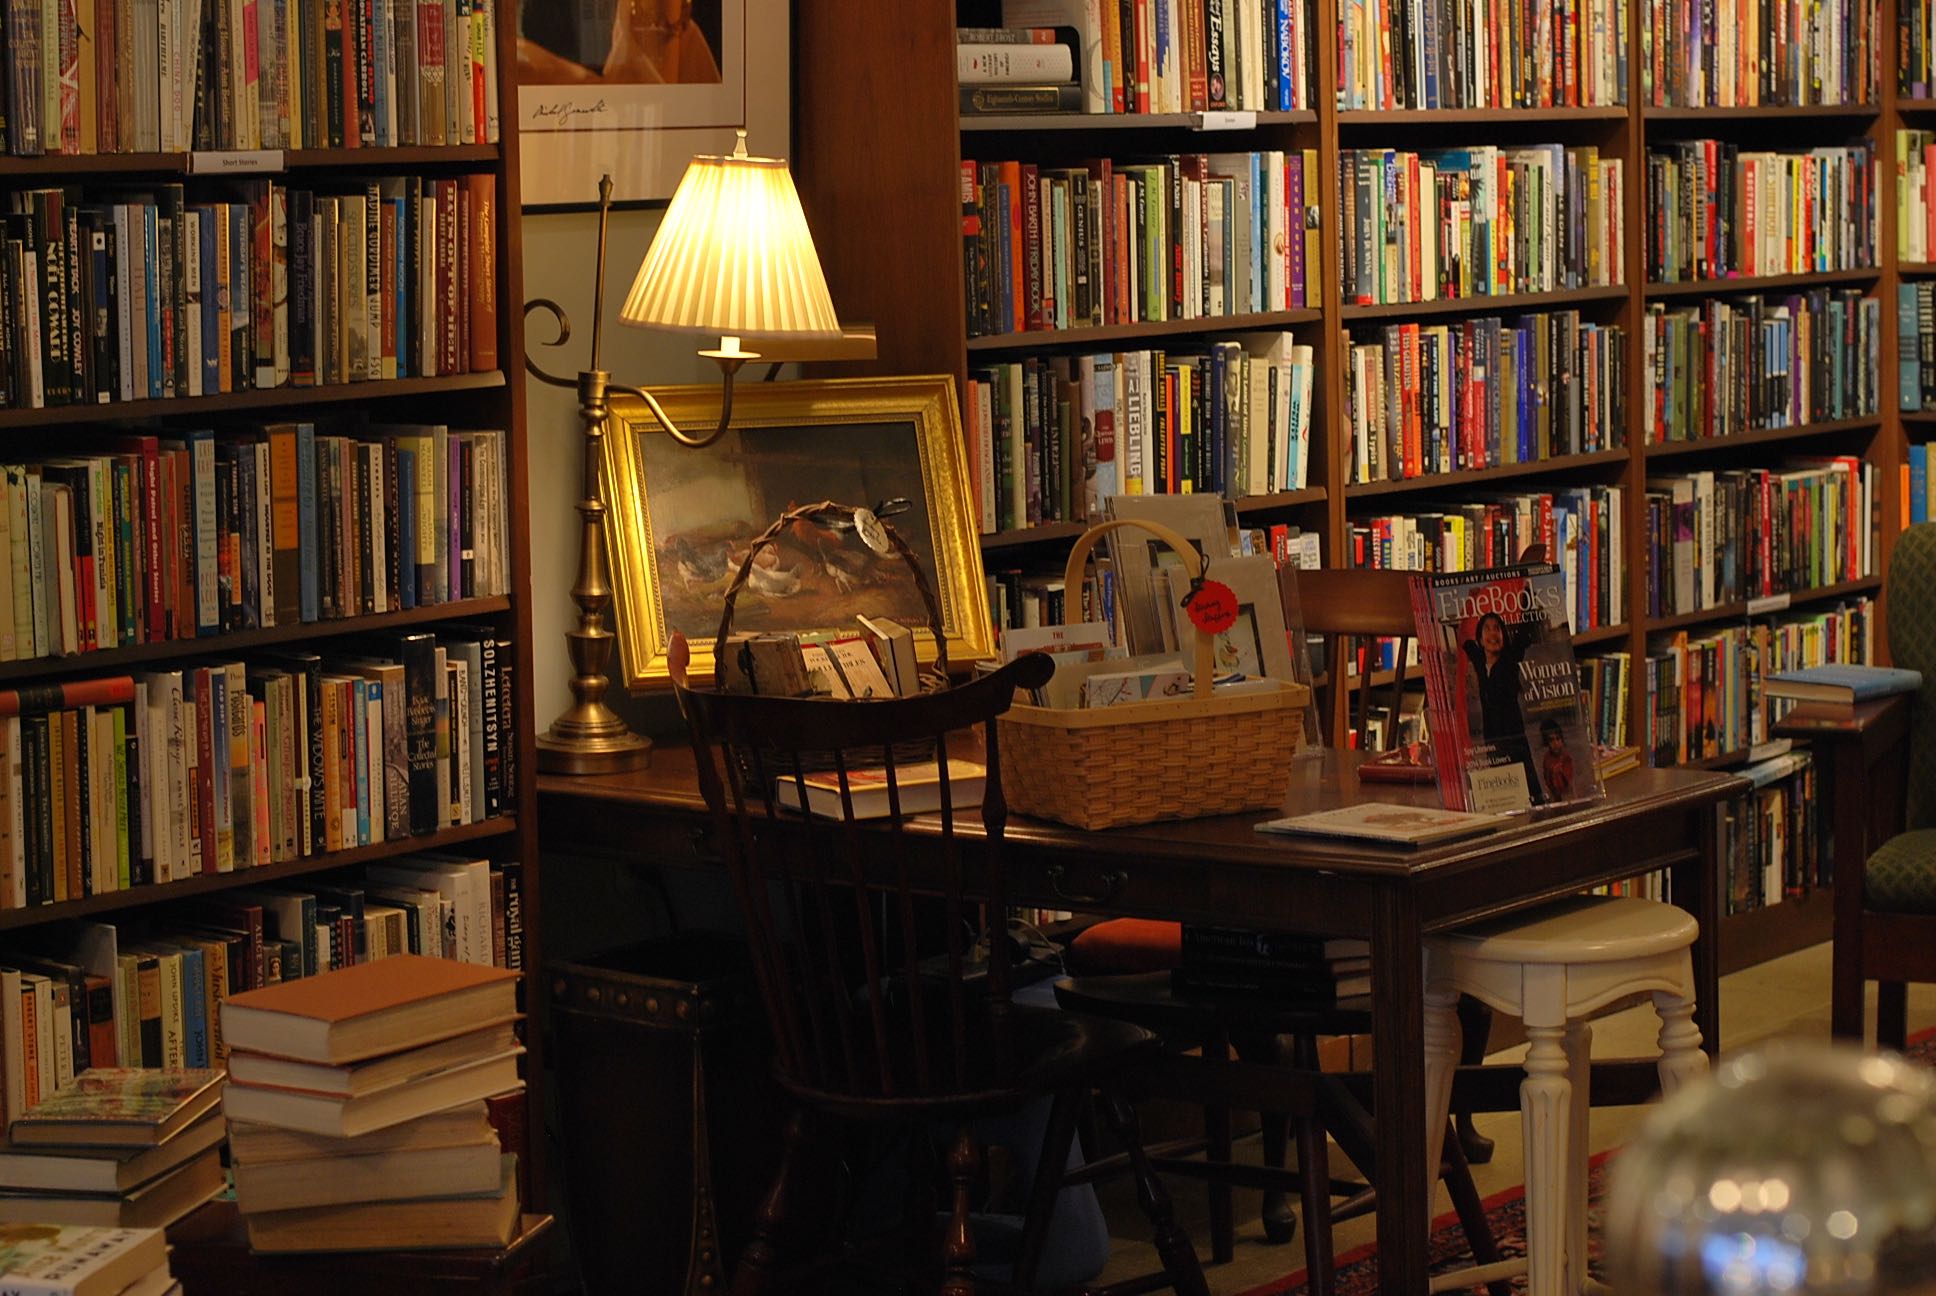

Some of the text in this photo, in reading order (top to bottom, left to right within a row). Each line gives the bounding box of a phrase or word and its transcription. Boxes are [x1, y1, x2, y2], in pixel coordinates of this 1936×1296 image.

[1208, 16, 1221, 72] Essays
[1279, 19, 1290, 79] NABOKOV
[223, 158, 237, 166] Short
[69, 217, 82, 375] HEART ATTACK JOY COWLEY
[240, 272, 248, 310] WEATHER
[297, 274, 308, 323] Friedman
[1242, 404, 1249, 415] of
[1392, 354, 1404, 459] Elizabeth George
[1128, 396, 1141, 475] LIEBLING
[147, 460, 156, 487] Night
[96, 521, 104, 545] Night
[150, 522, 158, 541] and
[98, 556, 107, 589] Tunisia
[151, 542, 159, 569] Other
[152, 571, 160, 604] Stories
[1435, 578, 1459, 587] BOOKS
[1466, 575, 1479, 583] ART
[1486, 570, 1521, 581] AUCTIONS
[1437, 579, 1561, 621] FineBooks
[1518, 660, 1572, 681] Women
[483, 639, 498, 752] SOLZHENITSYN
[1530, 680, 1575, 699] Vision
[231, 690, 246, 737] Postcards
[506, 892, 523, 934] royal
